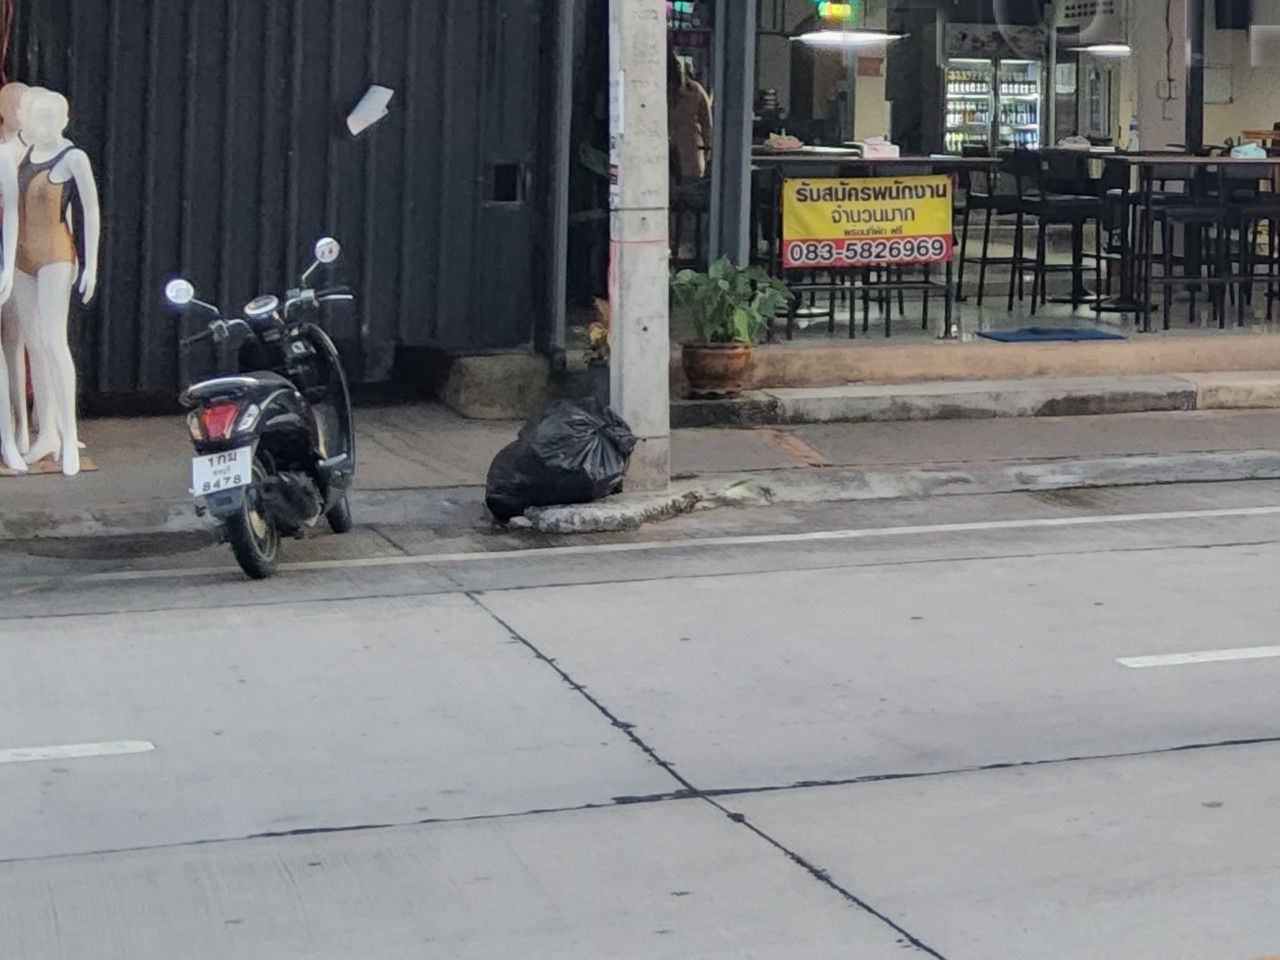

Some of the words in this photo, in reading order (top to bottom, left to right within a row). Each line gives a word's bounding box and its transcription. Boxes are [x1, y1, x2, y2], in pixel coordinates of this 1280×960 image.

[796, 181, 947, 203] รับสมัครพนักงาน
[831, 204, 915, 224] จำนวนมาก
[789, 237, 946, 262] 083-5826969
[203, 474, 241, 492] 8478
